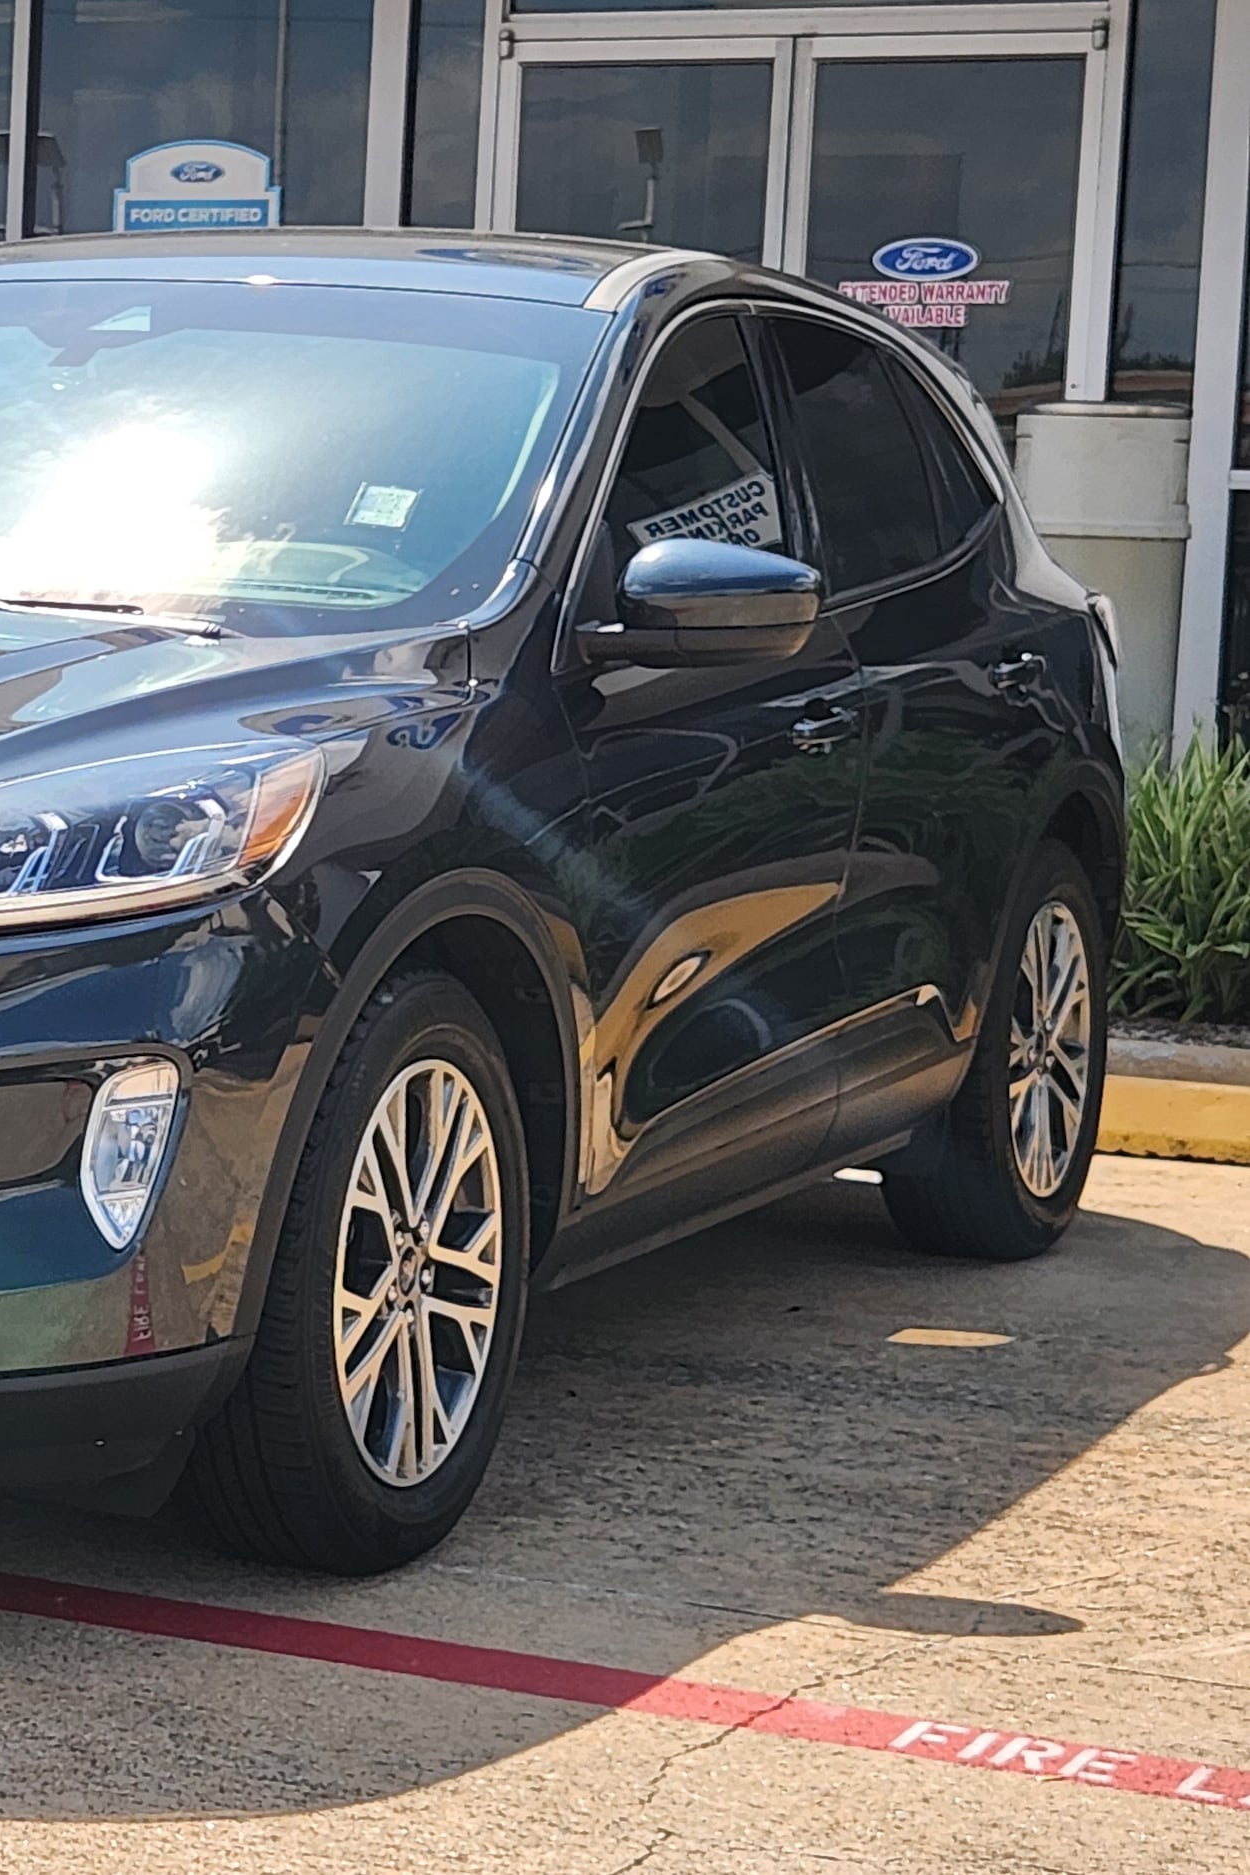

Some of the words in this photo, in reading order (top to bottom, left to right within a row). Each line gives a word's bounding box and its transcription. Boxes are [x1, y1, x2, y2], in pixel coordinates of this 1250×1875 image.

[178, 162, 217, 181] Ford
[129, 208, 175, 223] FORD
[177, 206, 263, 223] CERTIFIED
[894, 246, 959, 272] Ford
[922, 283, 1007, 302] WARRANTY
[886, 1720, 1138, 1784] FIRE
